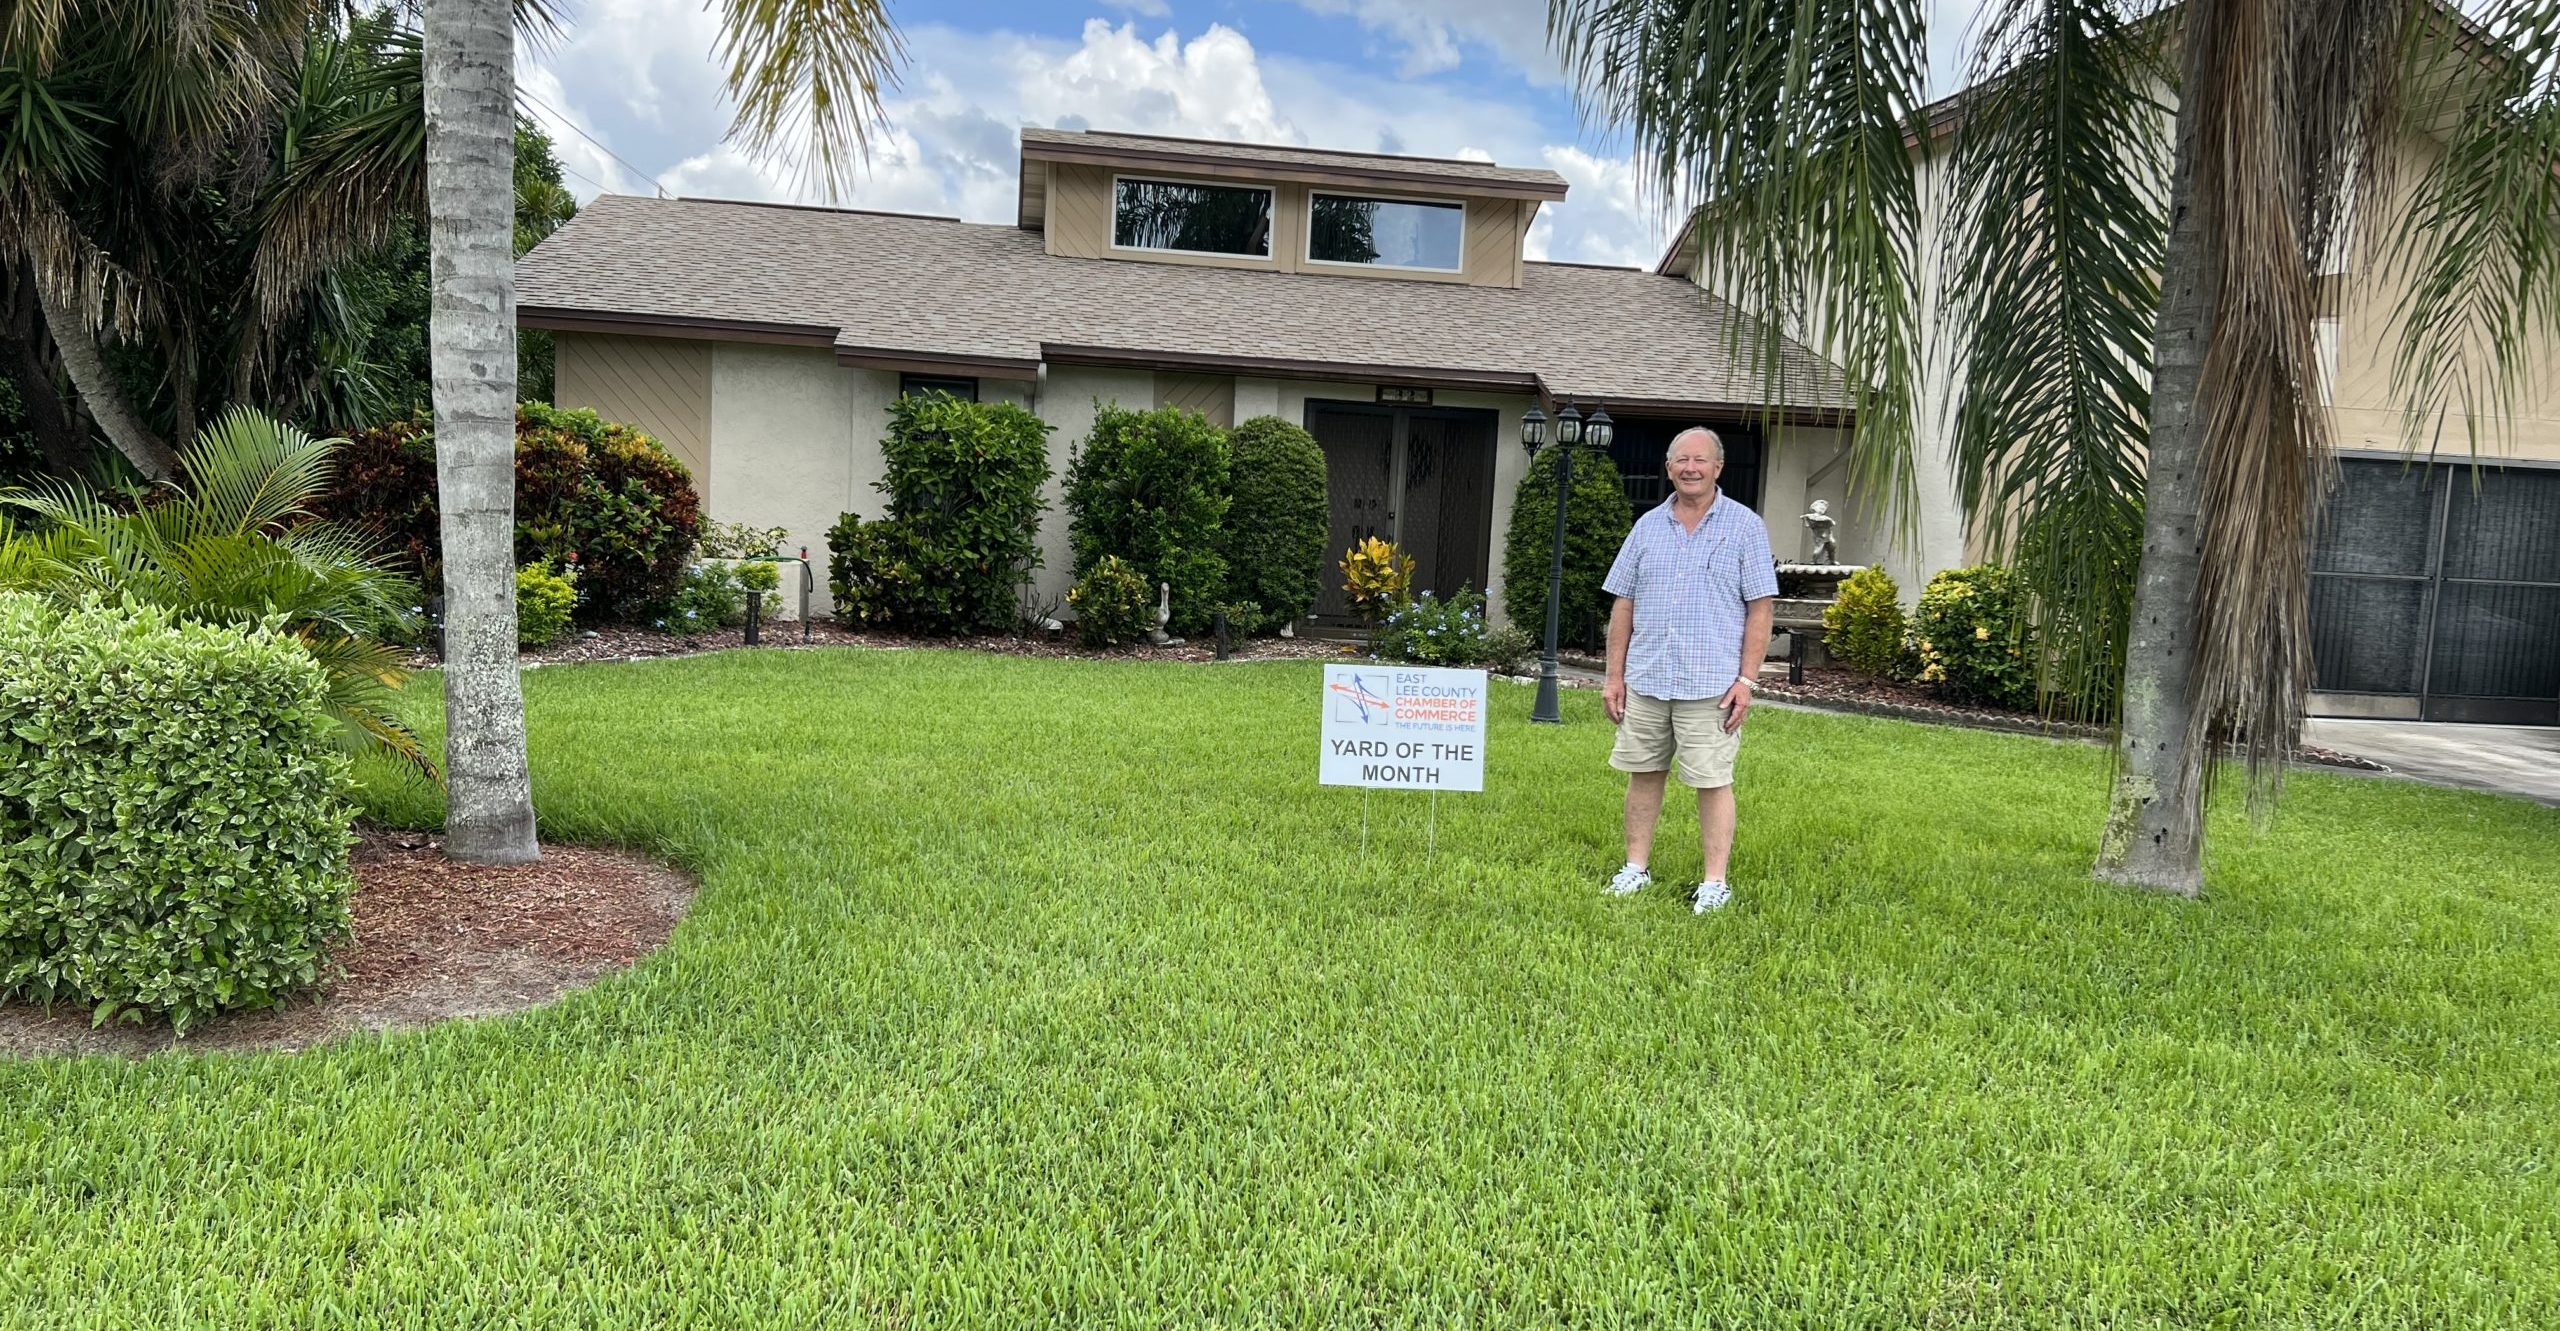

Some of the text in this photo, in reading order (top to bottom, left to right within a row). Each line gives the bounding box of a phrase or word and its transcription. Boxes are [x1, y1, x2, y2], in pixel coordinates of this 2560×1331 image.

[1396, 673, 1427, 684] EAST
[1396, 685, 1478, 698] LEE COUNTY
[1395, 697, 1477, 709] CHAMBER OF
[1395, 708, 1477, 722] COMMERCE
[1395, 722, 1476, 733] THE FUTURE IS HERE
[1331, 739, 1474, 761] YARD OF THE
[1362, 764, 1440, 784] MONTH
